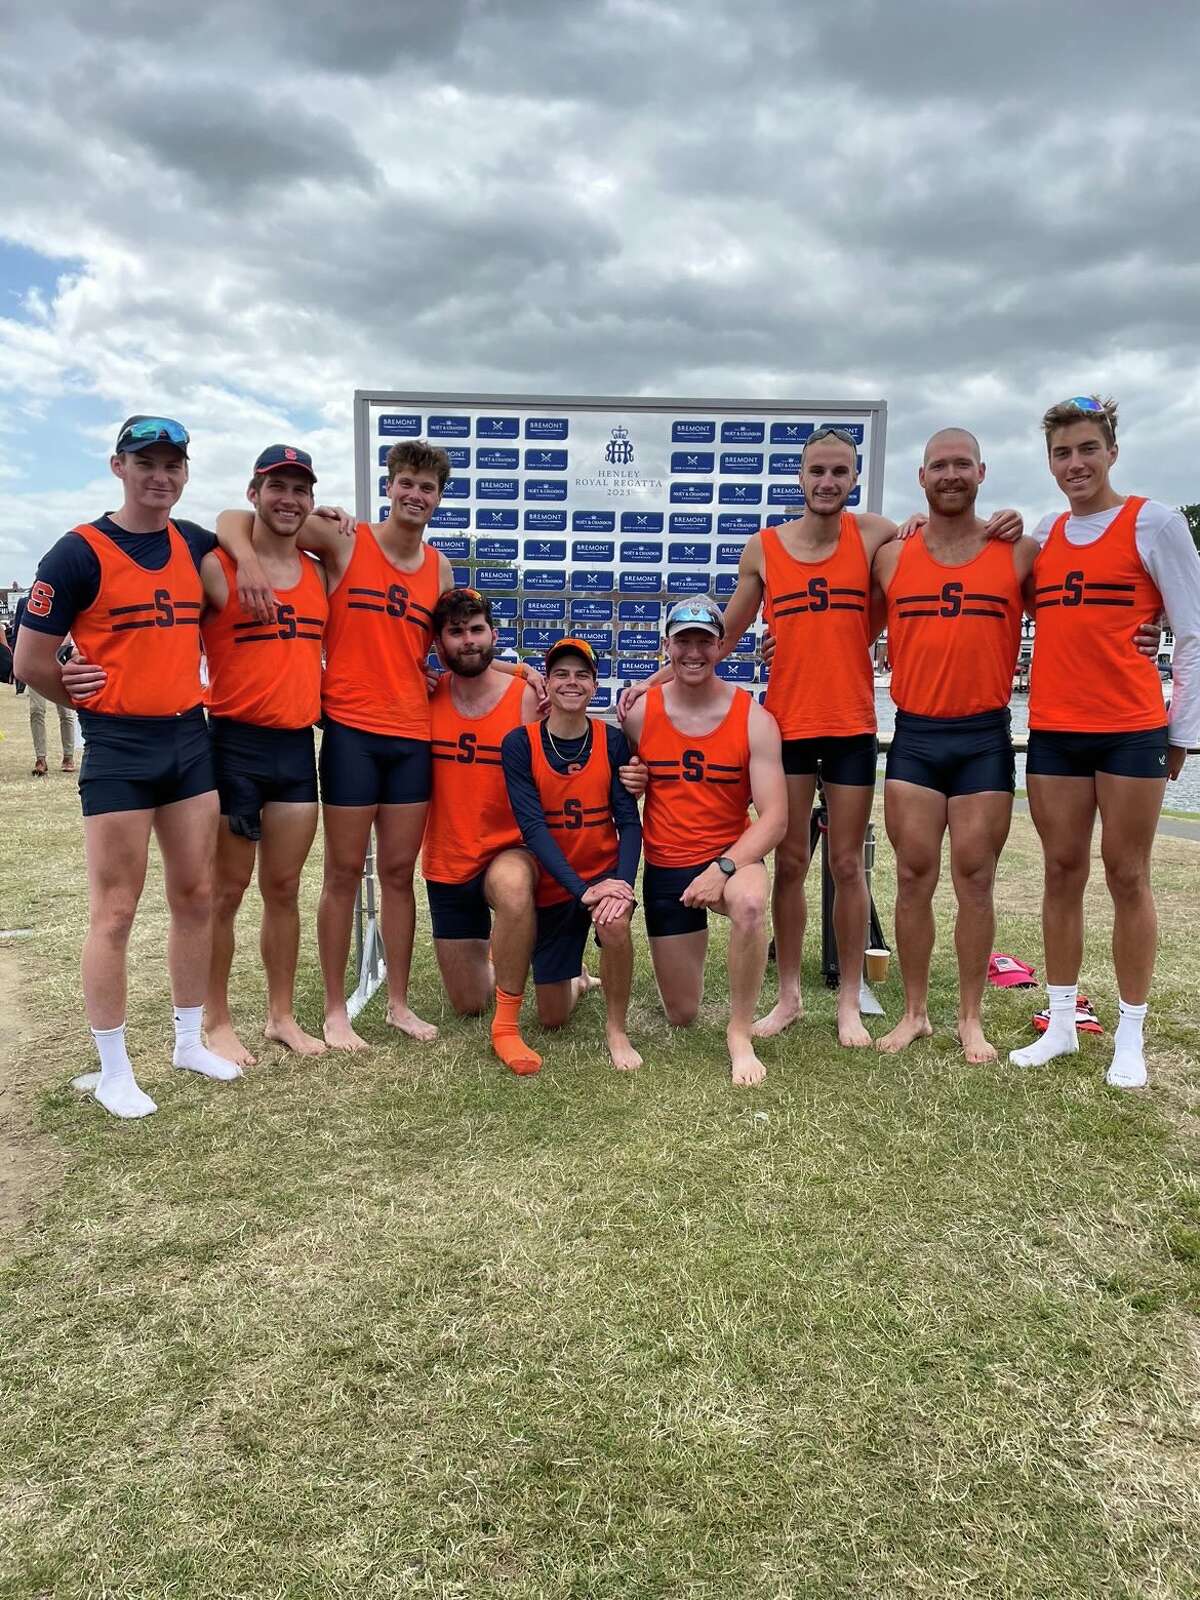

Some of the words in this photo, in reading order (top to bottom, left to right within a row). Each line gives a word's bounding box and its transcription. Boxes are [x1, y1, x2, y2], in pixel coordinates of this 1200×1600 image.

[284, 448, 297, 461] S
[598, 470, 640, 478] HENLEY
[614, 479, 662, 487] REGATTA
[27, 580, 55, 617] S
[386, 583, 409, 619] S
[807, 577, 829, 612] S
[940, 582, 964, 618] S
[1062, 570, 1085, 607] S
[154, 589, 175, 628] S
[276, 604, 297, 640] S
[456, 733, 476, 765] S
[682, 749, 705, 782] S
[564, 798, 583, 830] S
